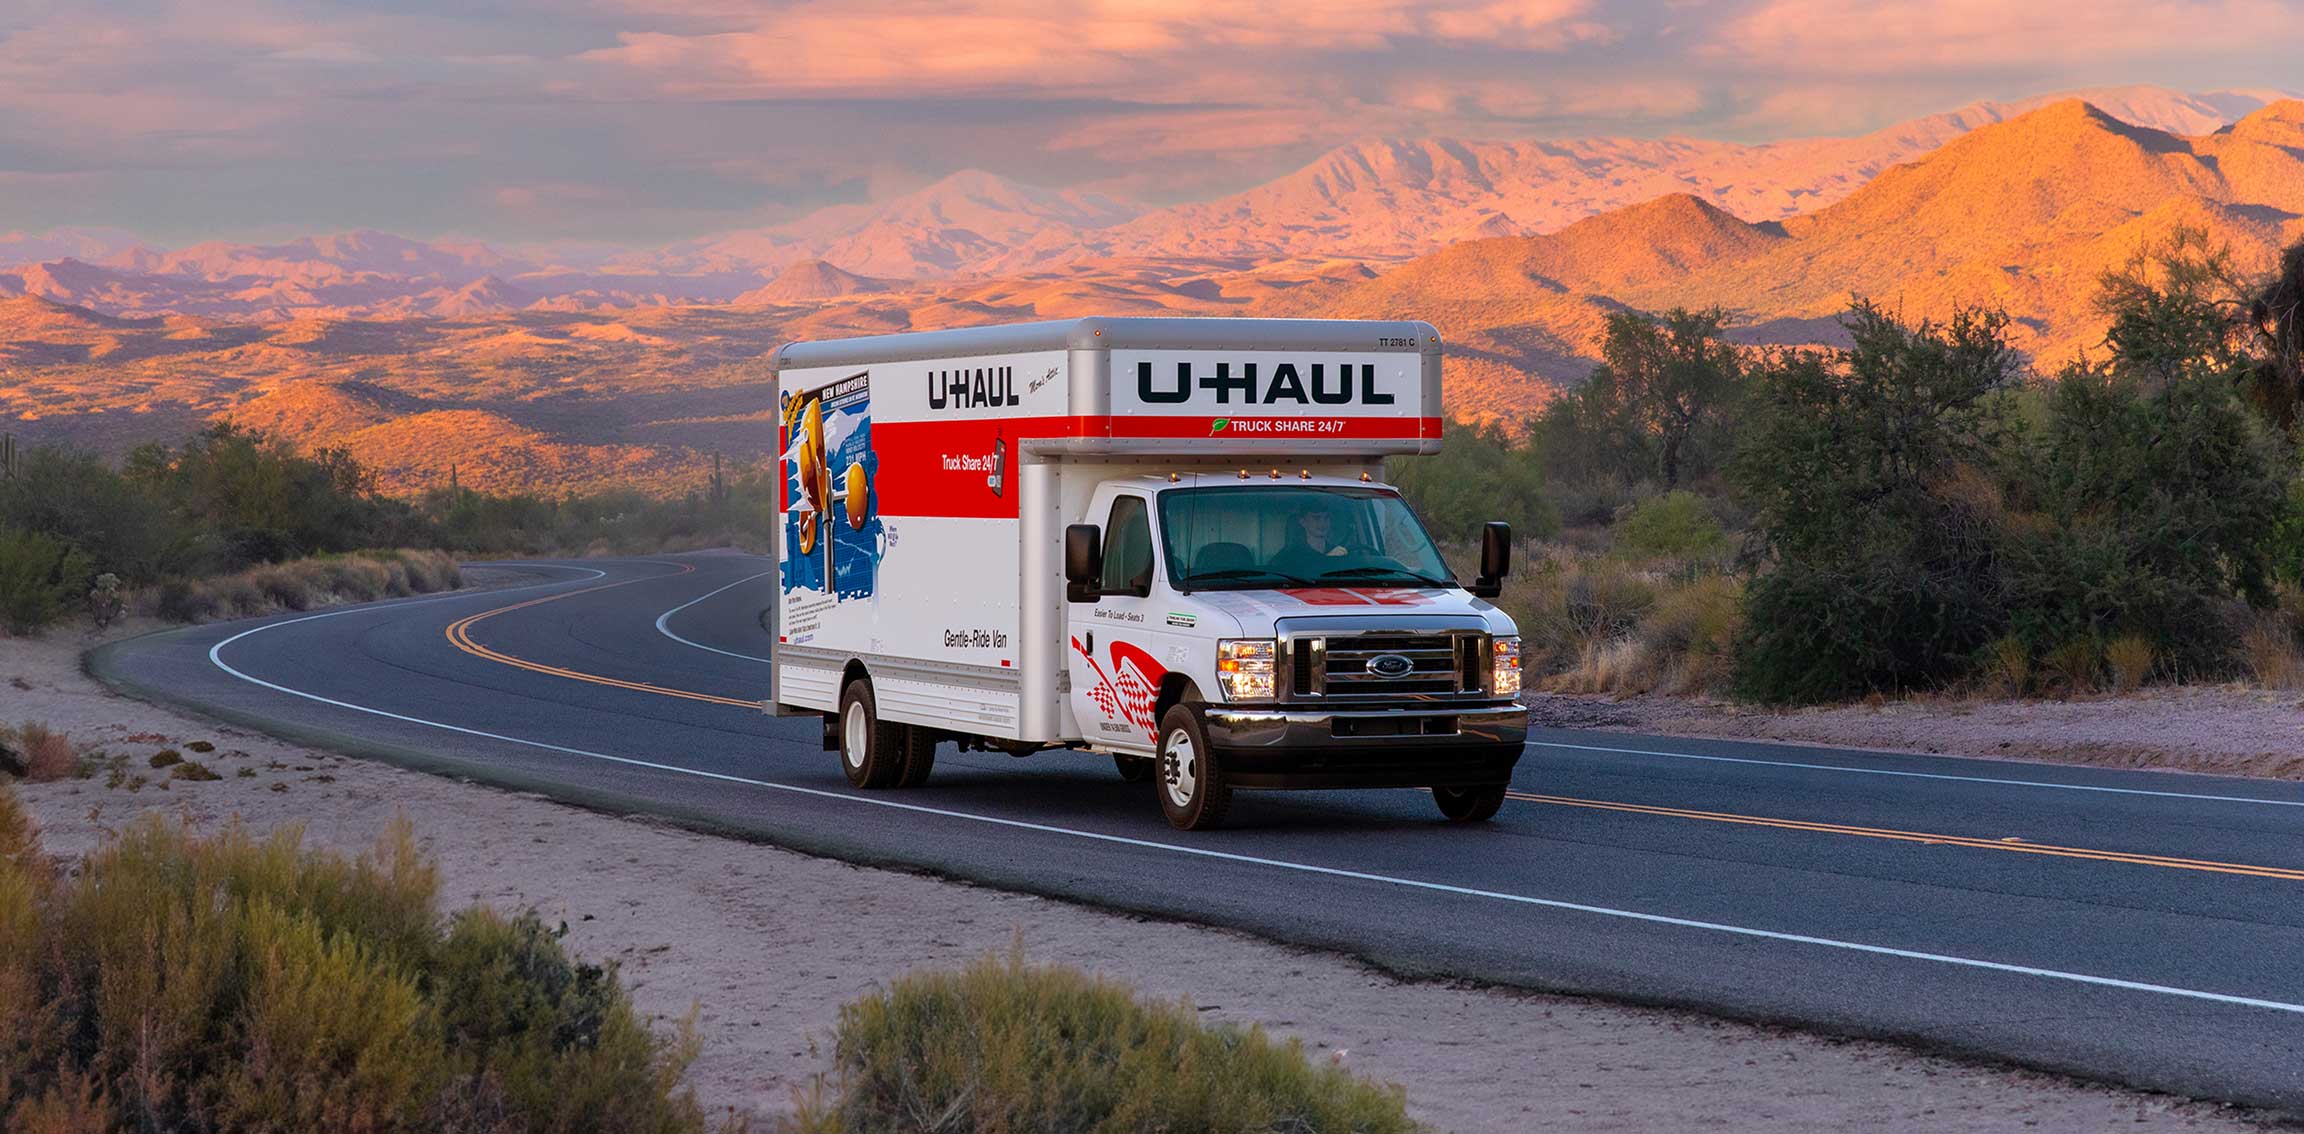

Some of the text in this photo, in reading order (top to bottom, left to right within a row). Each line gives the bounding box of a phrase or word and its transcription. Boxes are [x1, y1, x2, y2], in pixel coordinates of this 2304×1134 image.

[1379, 338, 1388, 346] TT
[1409, 338, 1415, 346] C
[822, 385, 835, 401] NEW
[835, 376, 867, 396] HAMPSHIRE
[928, 366, 1019, 410] U-HAUL
[1138, 362, 1395, 405] U-HAUL
[1231, 420, 1344, 433] TRUCK SHARE 24/7
[942, 452, 998, 474] Truck Share 24/7
[1094, 608, 1108, 618] Easier
[1108, 609, 1113, 619] To
[1113, 610, 1125, 620] Load
[1128, 611, 1141, 622] Seats
[944, 629, 1007, 648] Gentle-Ride Van
